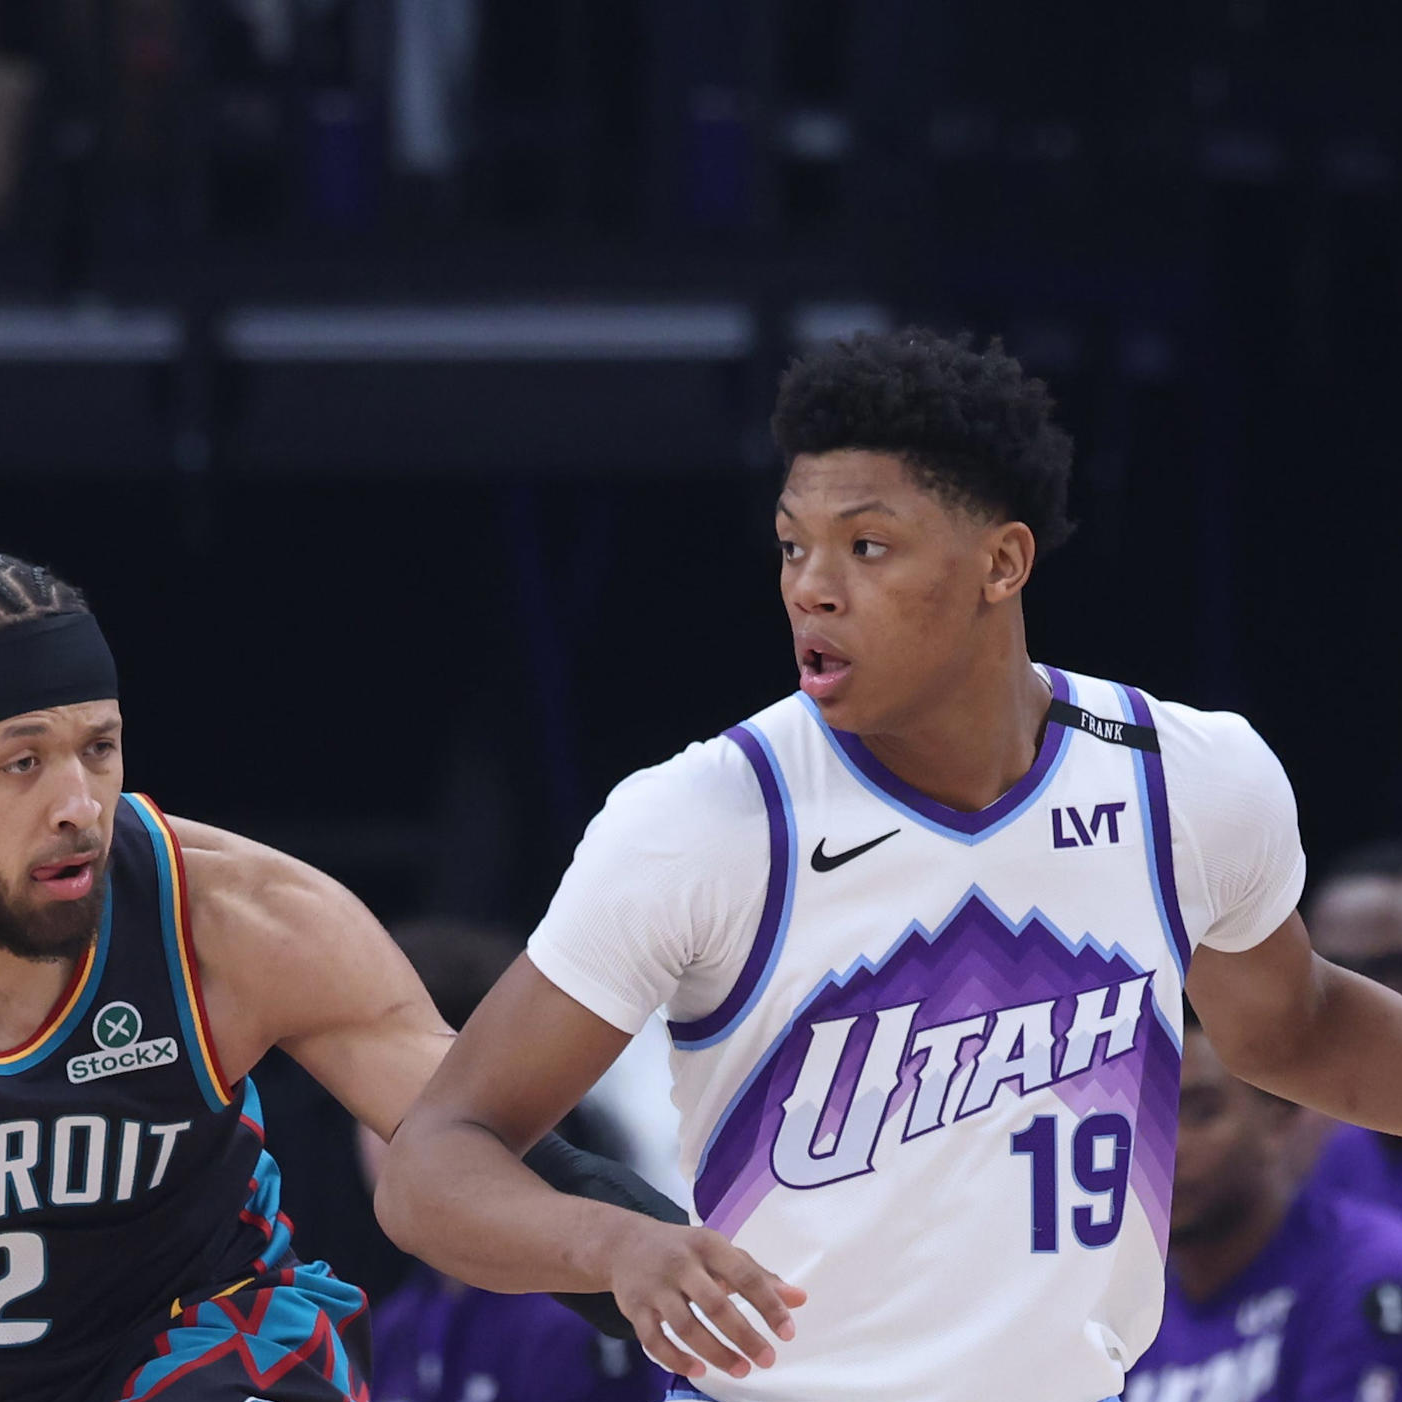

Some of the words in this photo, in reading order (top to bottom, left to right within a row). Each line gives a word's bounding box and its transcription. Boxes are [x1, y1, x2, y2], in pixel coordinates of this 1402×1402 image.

[1080, 711, 1124, 742] FRANK
[1051, 802, 1127, 850] LVT
[71, 1040, 174, 1080] StockX
[770, 970, 1156, 1190] UTAH
[1009, 1112, 1133, 1255] 19
